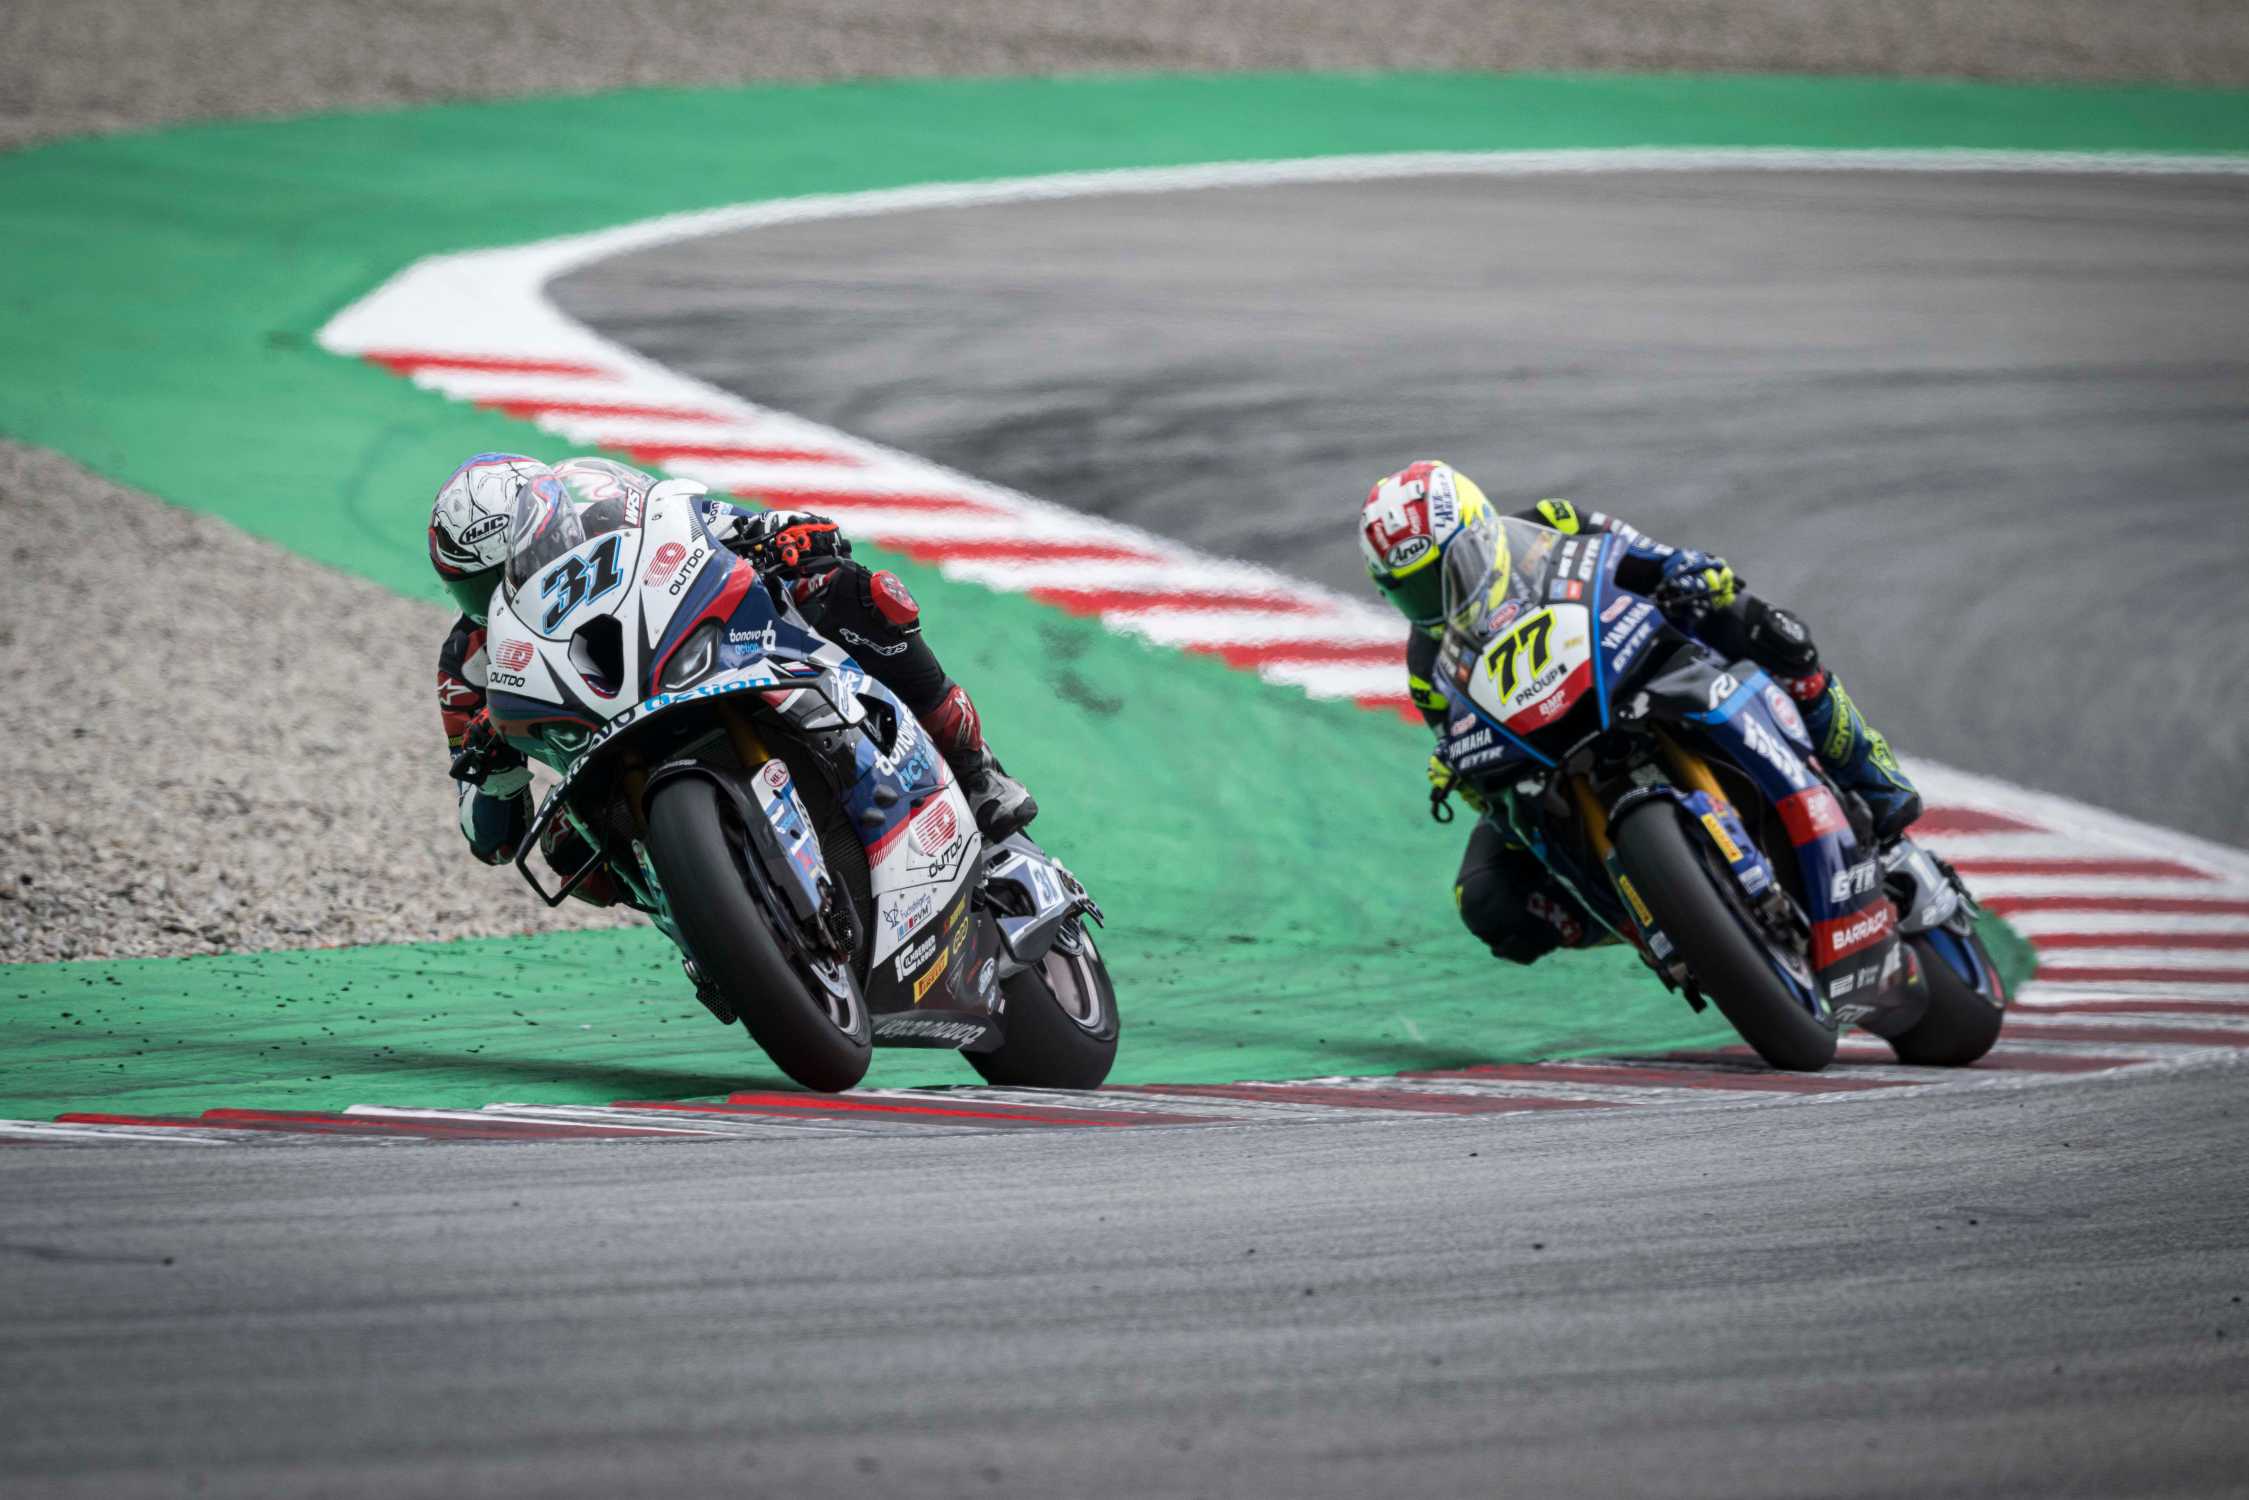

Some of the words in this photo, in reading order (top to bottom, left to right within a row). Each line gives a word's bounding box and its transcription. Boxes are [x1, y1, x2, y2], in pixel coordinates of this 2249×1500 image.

[465, 516, 509, 543] HJC
[1393, 539, 1425, 564] Arai
[541, 533, 623, 635] 31
[668, 547, 705, 596] OUTDO
[1601, 602, 1655, 650] YAMAHA
[1484, 608, 1557, 705] 77
[489, 670, 526, 688] OUTDO
[1448, 727, 1492, 760] YAMAHA
[928, 834, 963, 878] OUTDO
